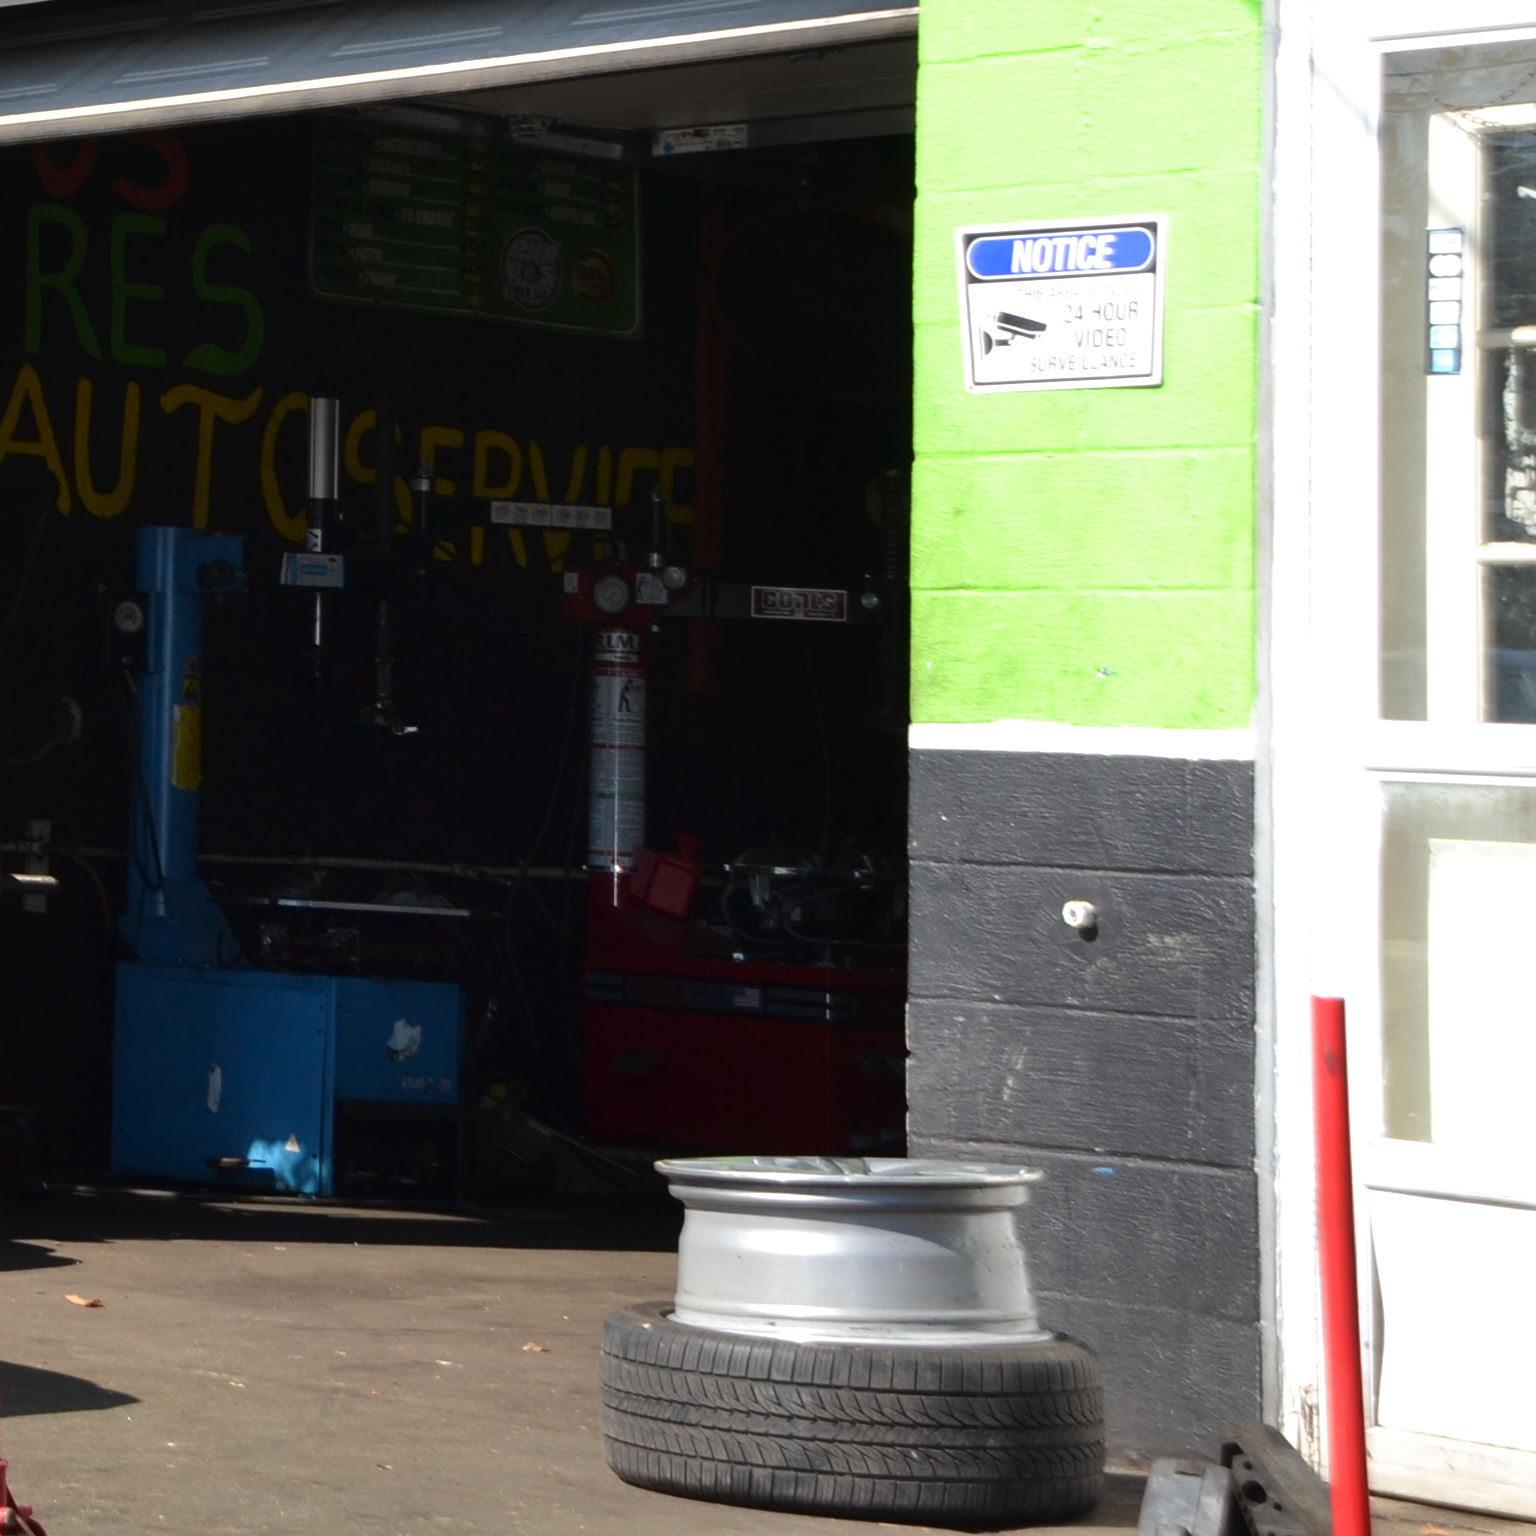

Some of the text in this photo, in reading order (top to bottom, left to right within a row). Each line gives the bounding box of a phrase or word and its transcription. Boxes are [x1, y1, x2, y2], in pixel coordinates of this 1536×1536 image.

[1011, 235, 1115, 273] NOTICE
[1064, 300, 1139, 324] 24 HOUR
[1074, 327, 1127, 348] VIDEO
[1030, 352, 1137, 373] SURVEILLANCE
